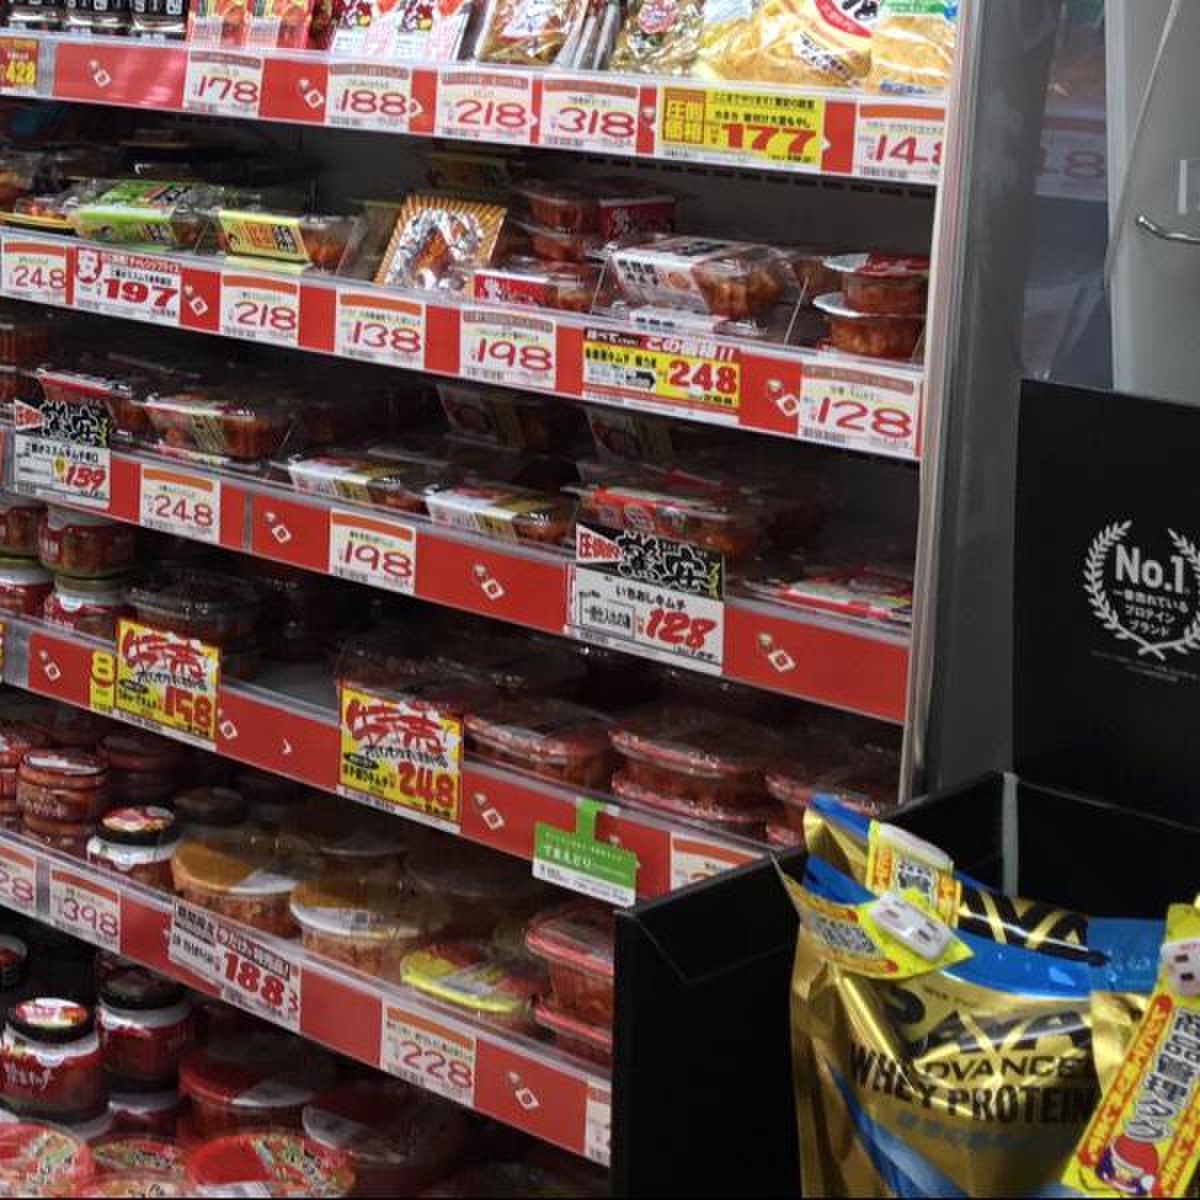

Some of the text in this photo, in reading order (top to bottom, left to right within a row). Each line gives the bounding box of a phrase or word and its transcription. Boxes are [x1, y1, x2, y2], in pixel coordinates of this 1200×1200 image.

[199, 75, 259, 104] 178
[341, 88, 407, 116] 188
[457, 98, 528, 129] 218
[558, 107, 636, 138] 318
[721, 122, 817, 155] 177
[15, 266, 66, 289] 248
[103, 278, 179, 307] 197
[237, 301, 297, 330] 218
[352, 320, 422, 353] 138
[477, 337, 553, 372] 198
[668, 360, 739, 395] 248
[816, 396, 913, 439] 128
[154, 493, 214, 528] 248
[343, 540, 412, 578] 198
[1115, 543, 1186, 594] No.1
[645, 607, 718, 649] 128
[397, 758, 455, 810] 248
[61, 896, 119, 938] 398
[222, 952, 286, 1008] 188
[399, 1039, 474, 1090] 228
[848, 1042, 937, 1110] WHEY
